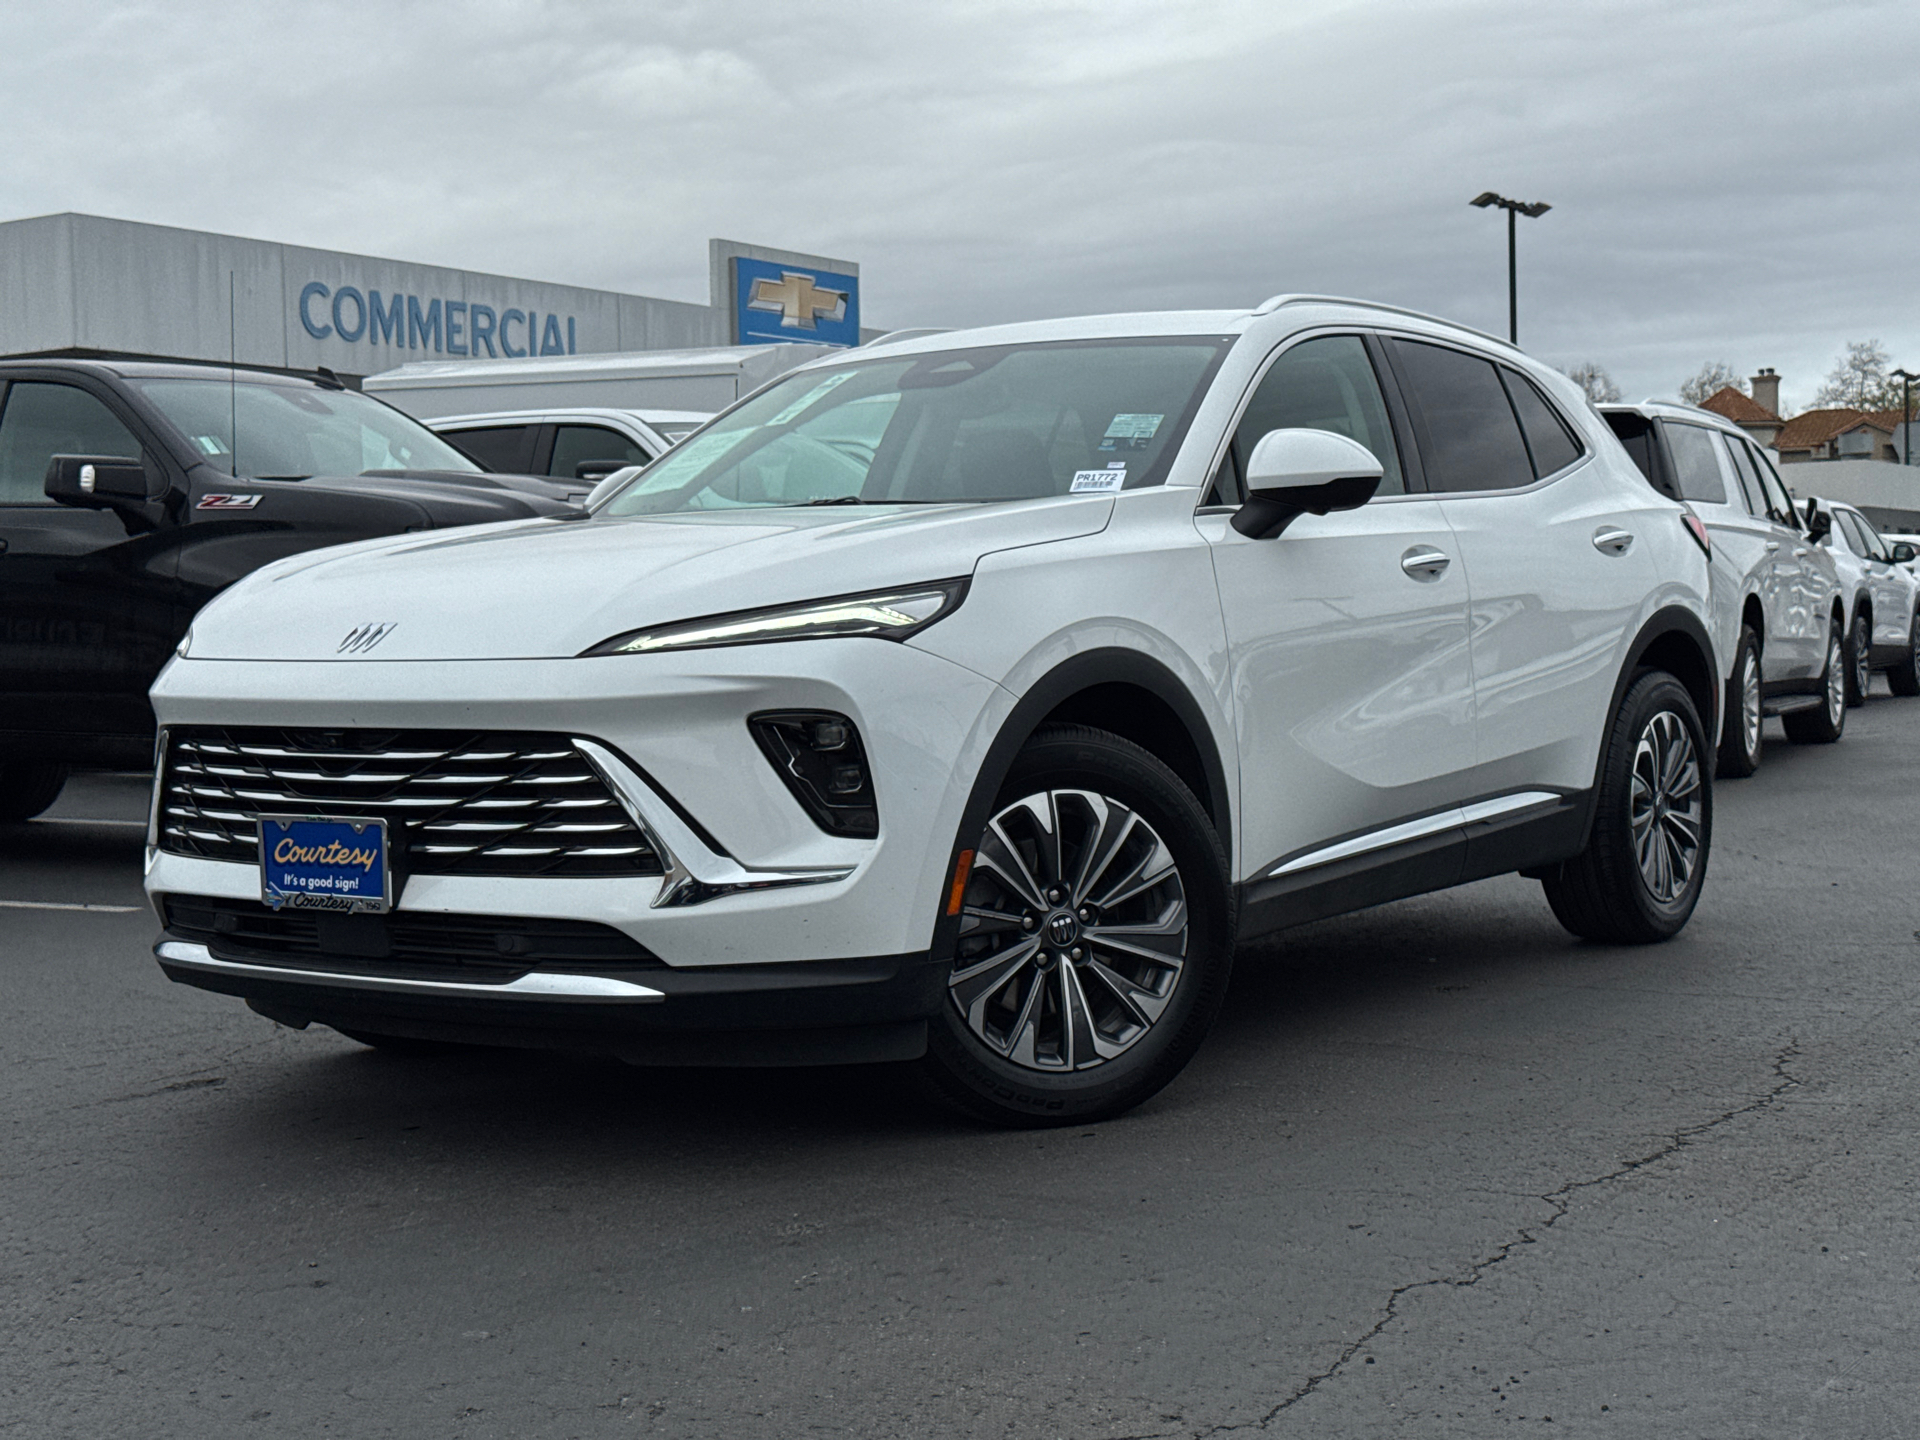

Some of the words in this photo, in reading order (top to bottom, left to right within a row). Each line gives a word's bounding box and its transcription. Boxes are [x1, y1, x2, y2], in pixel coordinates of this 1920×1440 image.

[299, 282, 577, 358] COMMERCIAL
[1076, 473, 1118, 482] PR1772
[195, 494, 264, 510] Z71
[274, 838, 377, 872] Courtesy
[284, 873, 298, 886] It's
[299, 877, 307, 886] a
[308, 875, 333, 890] good
[335, 875, 360, 892] sign!
[294, 892, 355, 915] Courtesy
